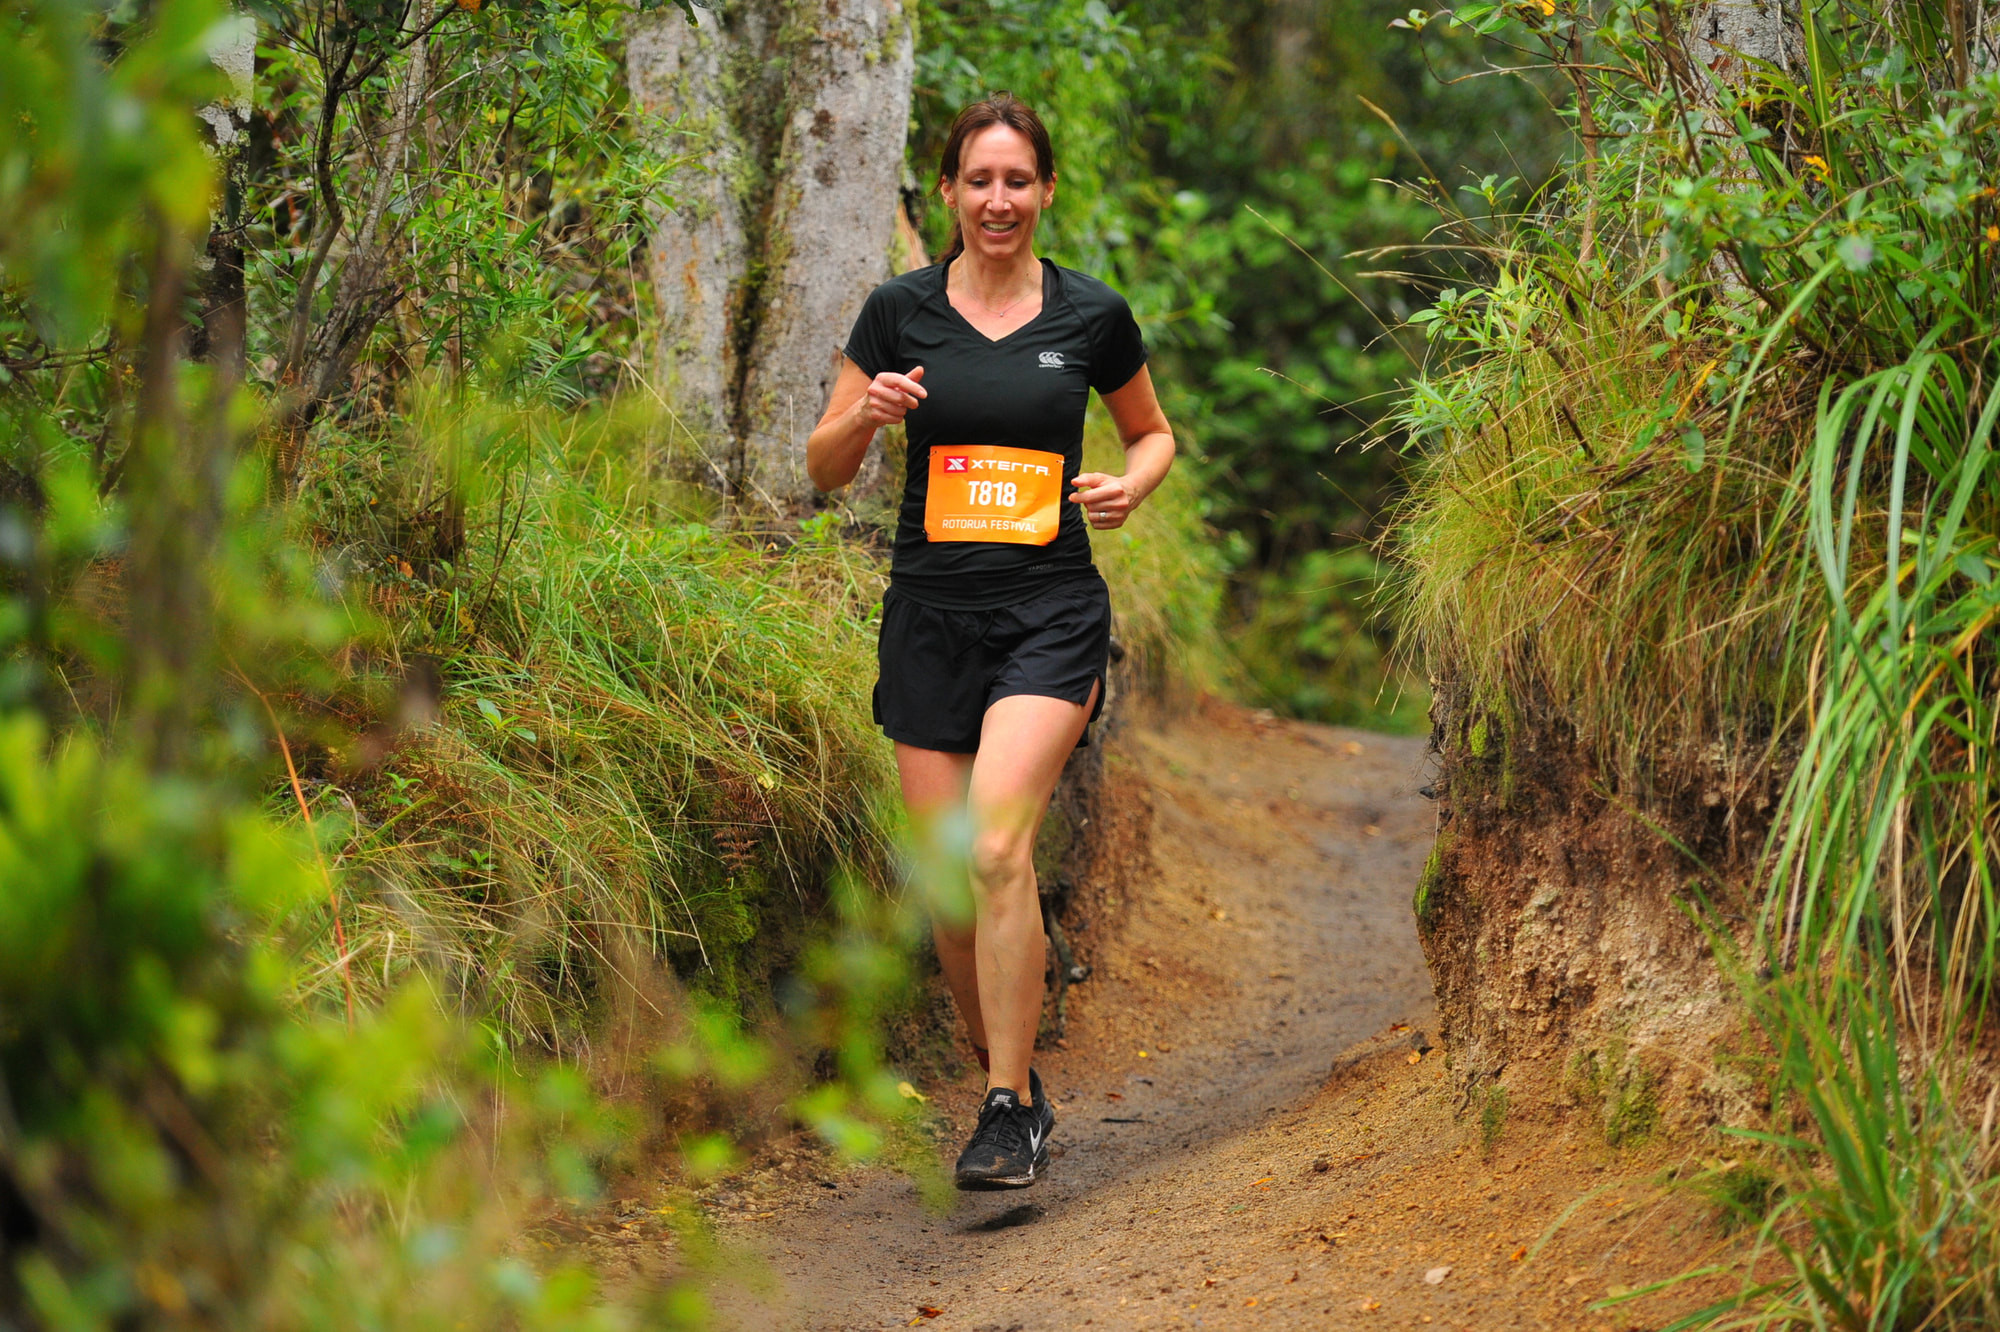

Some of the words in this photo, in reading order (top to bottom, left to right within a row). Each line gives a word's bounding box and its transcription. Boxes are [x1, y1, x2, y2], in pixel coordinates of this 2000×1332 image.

[971, 459, 1049, 476] XTERRA
[968, 480, 1017, 507] T818
[942, 519, 987, 529] ROTORUA
[990, 520, 1038, 533] FESTIVAL
